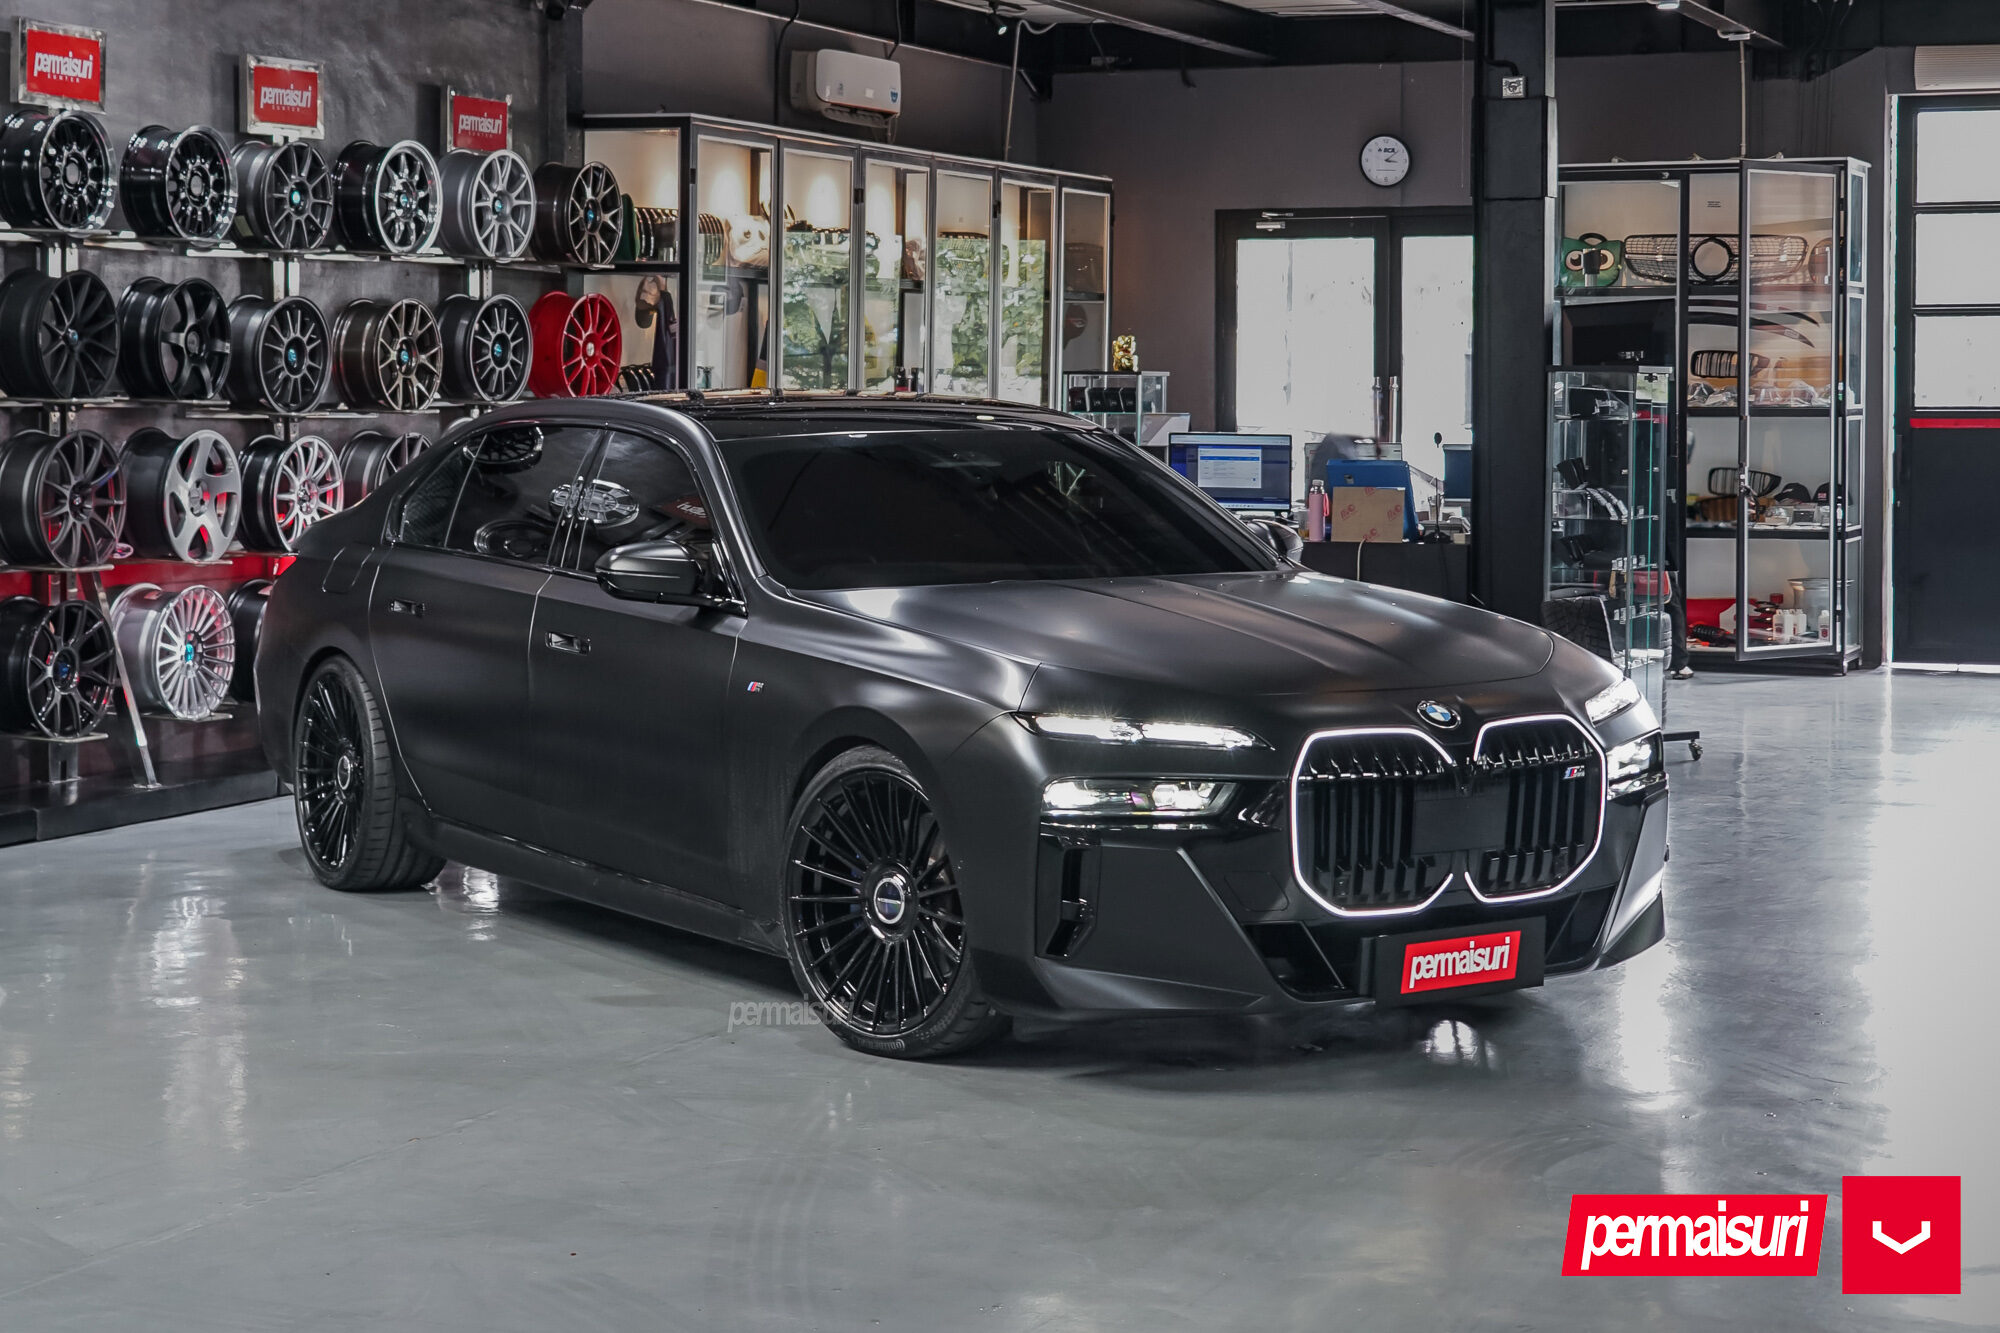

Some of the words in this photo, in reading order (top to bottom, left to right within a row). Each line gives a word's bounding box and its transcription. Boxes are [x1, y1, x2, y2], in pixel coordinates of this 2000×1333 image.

[33, 50, 93, 79] permaisuri
[260, 83, 312, 109] permaisuri
[458, 112, 503, 135] permaisuri
[1409, 936, 1511, 989] permaisuri
